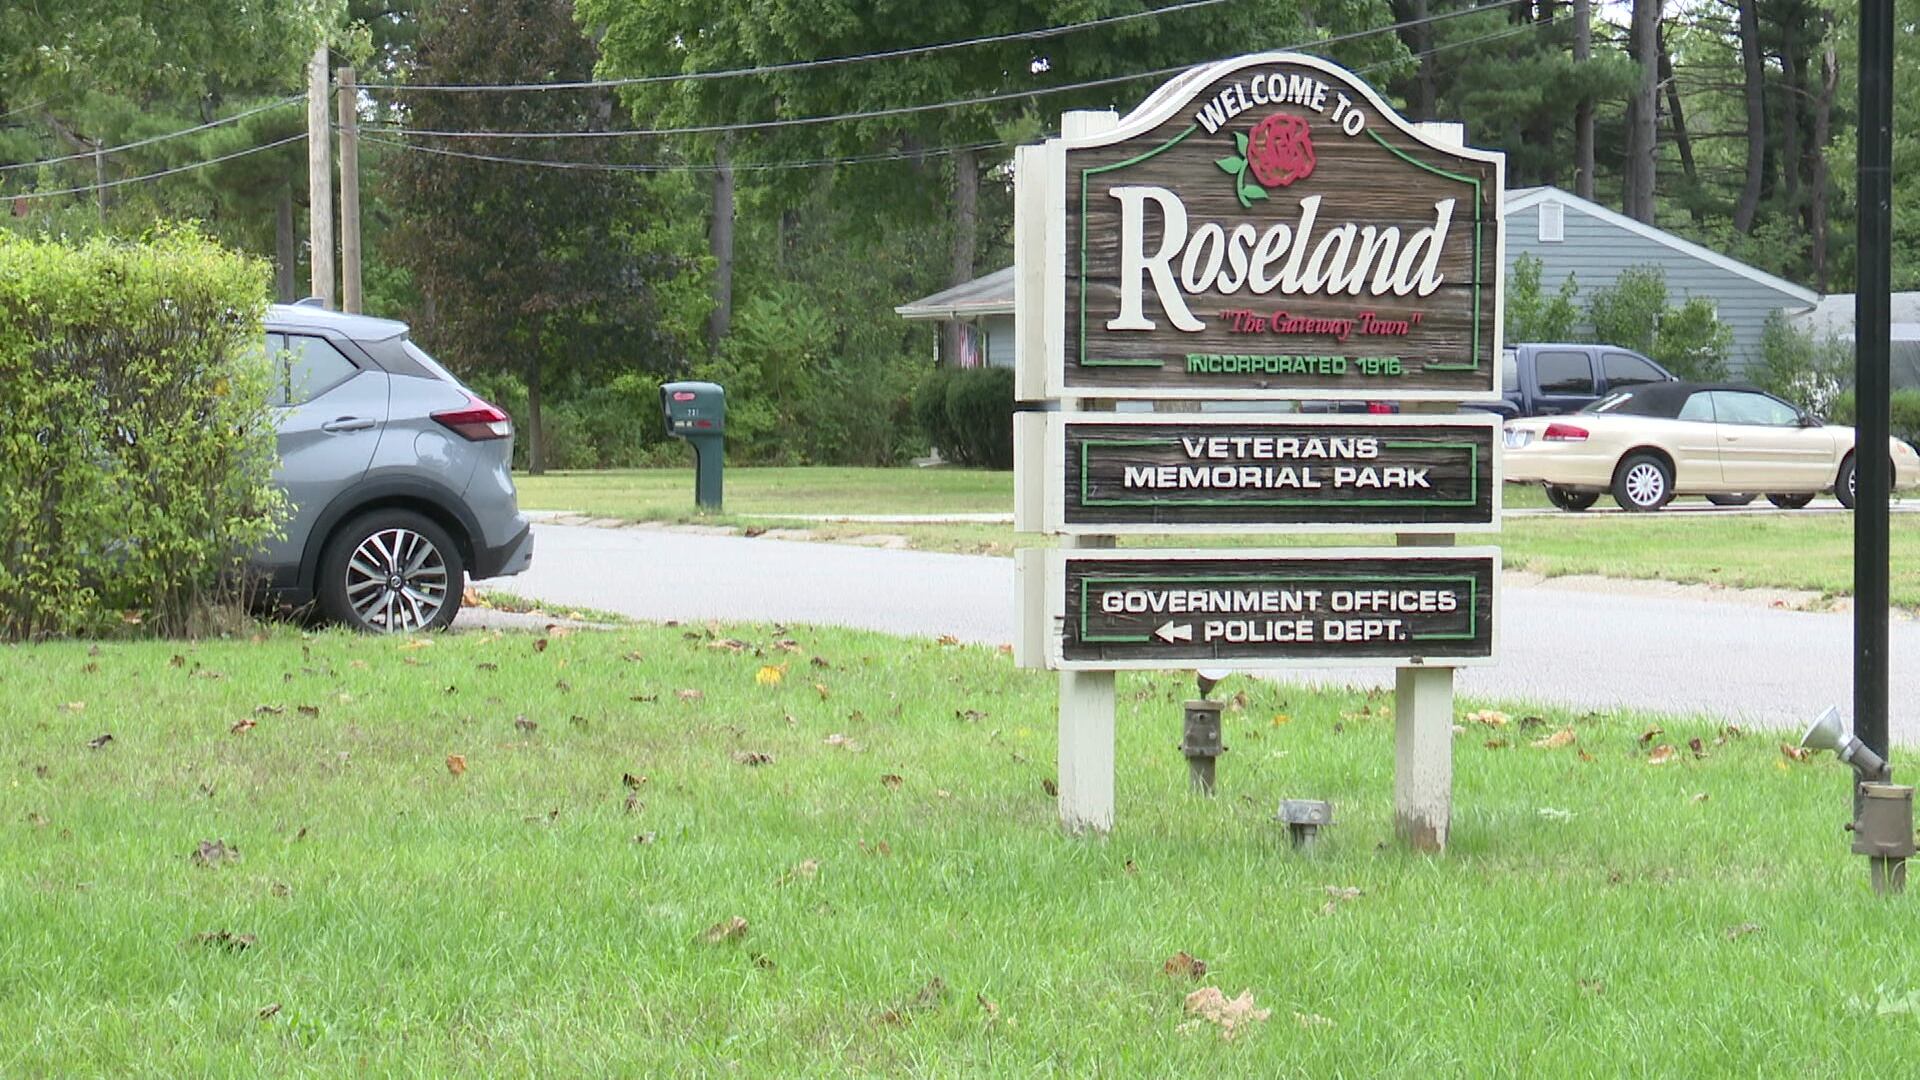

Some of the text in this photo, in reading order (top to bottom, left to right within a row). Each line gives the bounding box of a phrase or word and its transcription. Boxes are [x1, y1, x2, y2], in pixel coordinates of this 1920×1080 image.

[1195, 73, 1366, 136] WELCOME TO
[1106, 186, 1456, 332] Roseland
[1220, 309, 1424, 341] "The Gateway Town"
[1186, 353, 1347, 375] INCORPORATED
[1181, 437, 1379, 459] VETERANS
[1123, 466, 1431, 489] MEMORIAL PARK
[1101, 590, 1457, 613] GOVERNMENT OFFICES
[1204, 619, 1407, 642] POLICE DEPT.
